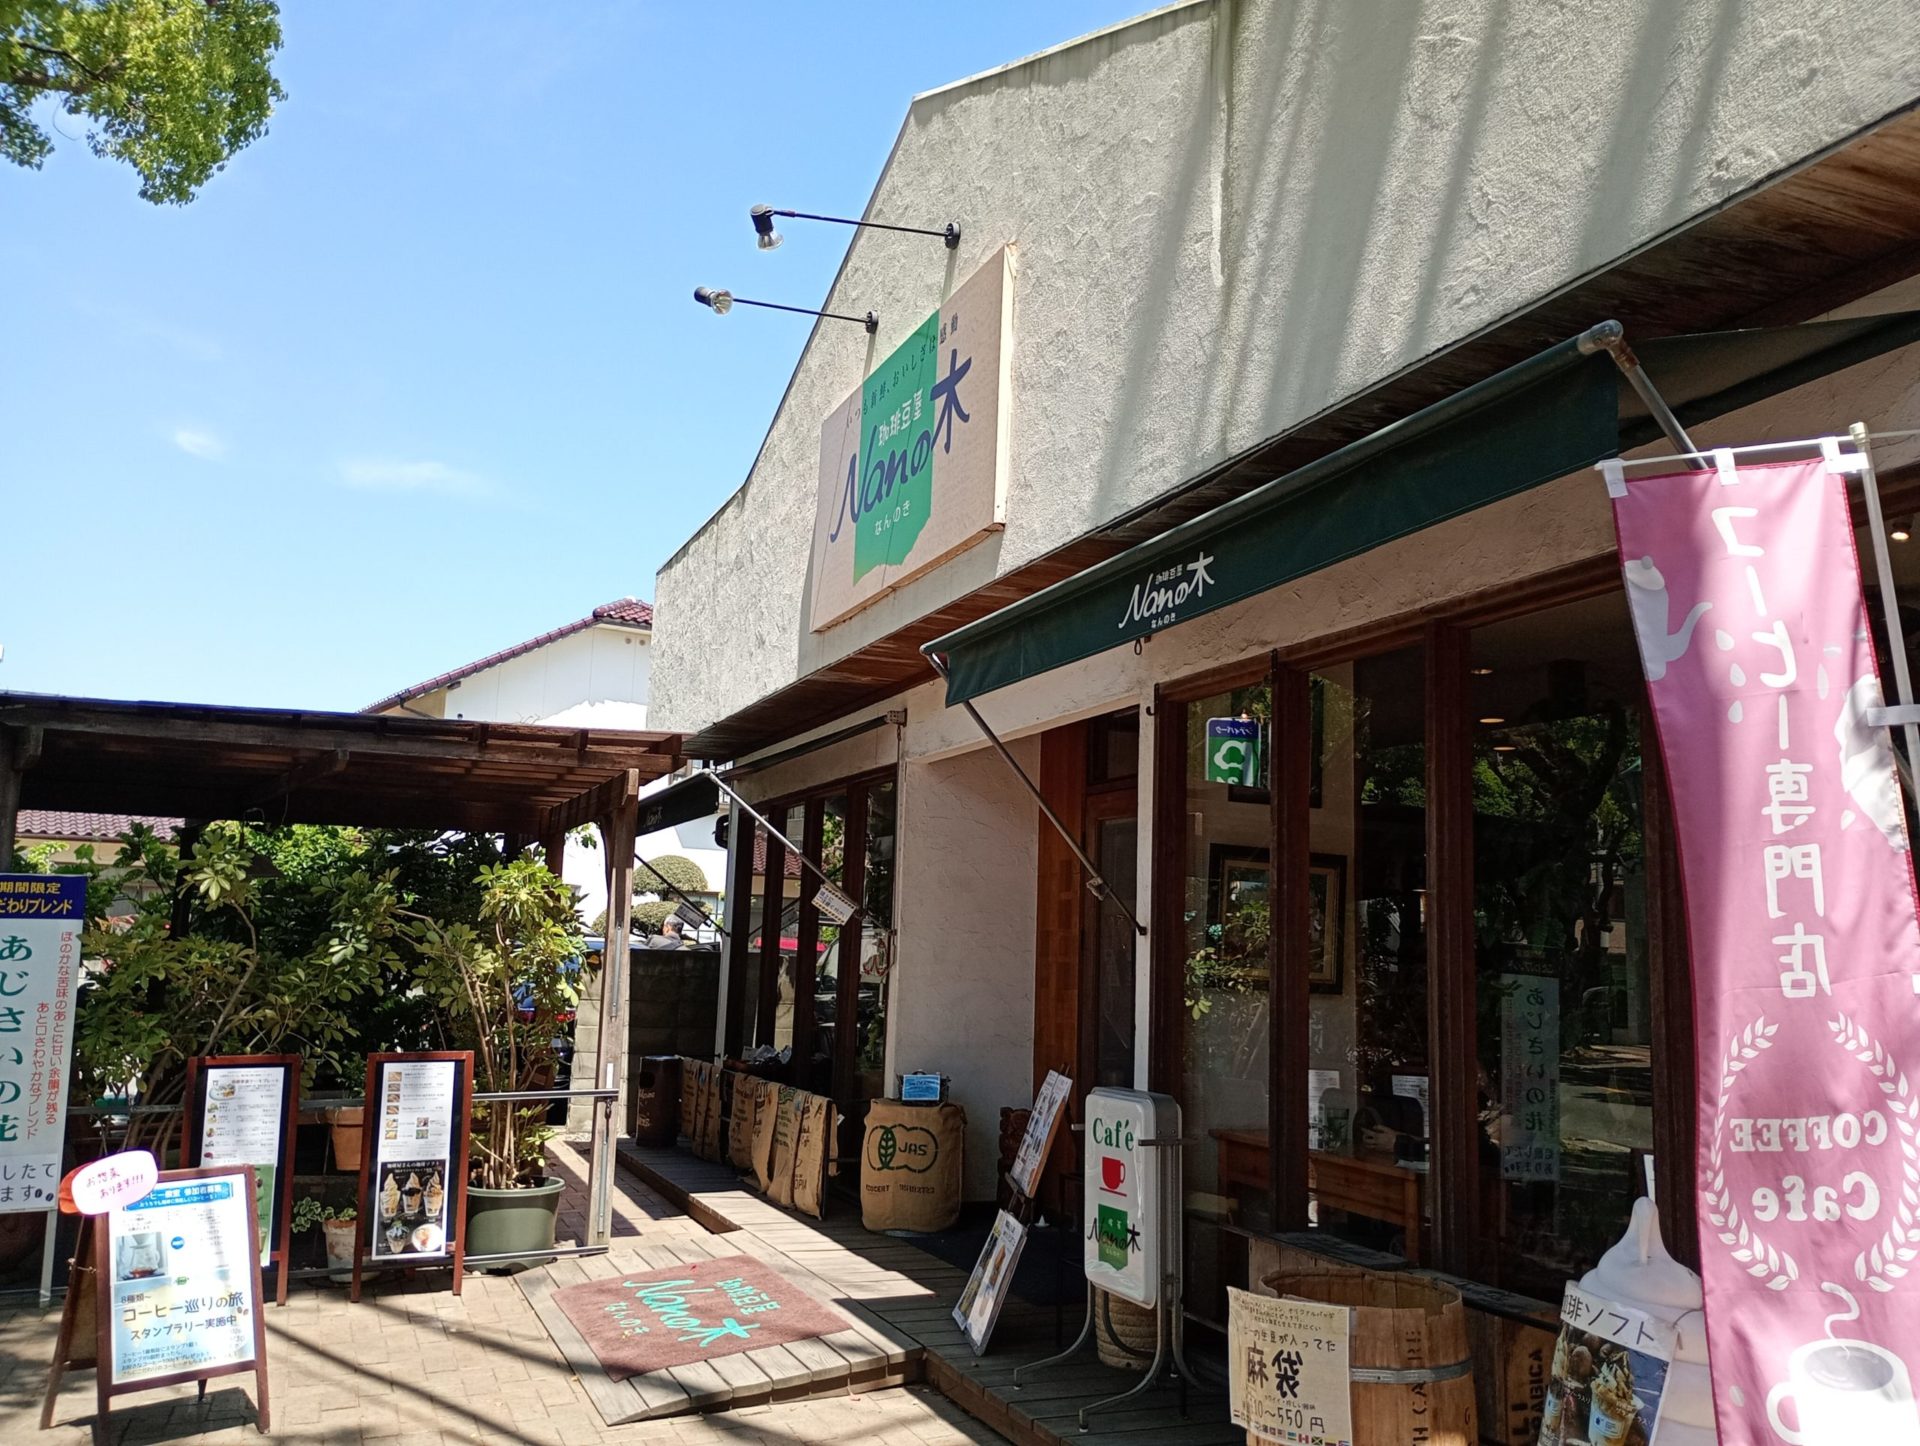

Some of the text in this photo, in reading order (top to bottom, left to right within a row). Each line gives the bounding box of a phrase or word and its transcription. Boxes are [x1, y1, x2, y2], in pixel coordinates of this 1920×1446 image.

[874, 500, 911, 536] なんのき
[0, 881, 61, 895] 期間限定
[45, 931, 74, 1126] ほのかな苦味のあとに甘い余韻が残る
[27, 1001, 50, 1141] あと口さわやかなブレンド
[898, 1142, 929, 1156] JAS
[1092, 1117, 1135, 1152] Café
[123, 1291, 244, 1323] コーヒー巡りの旅
[130, 1314, 238, 1342] スタンプラリー実施中
[1247, 1340, 1304, 1399] 麻袋
